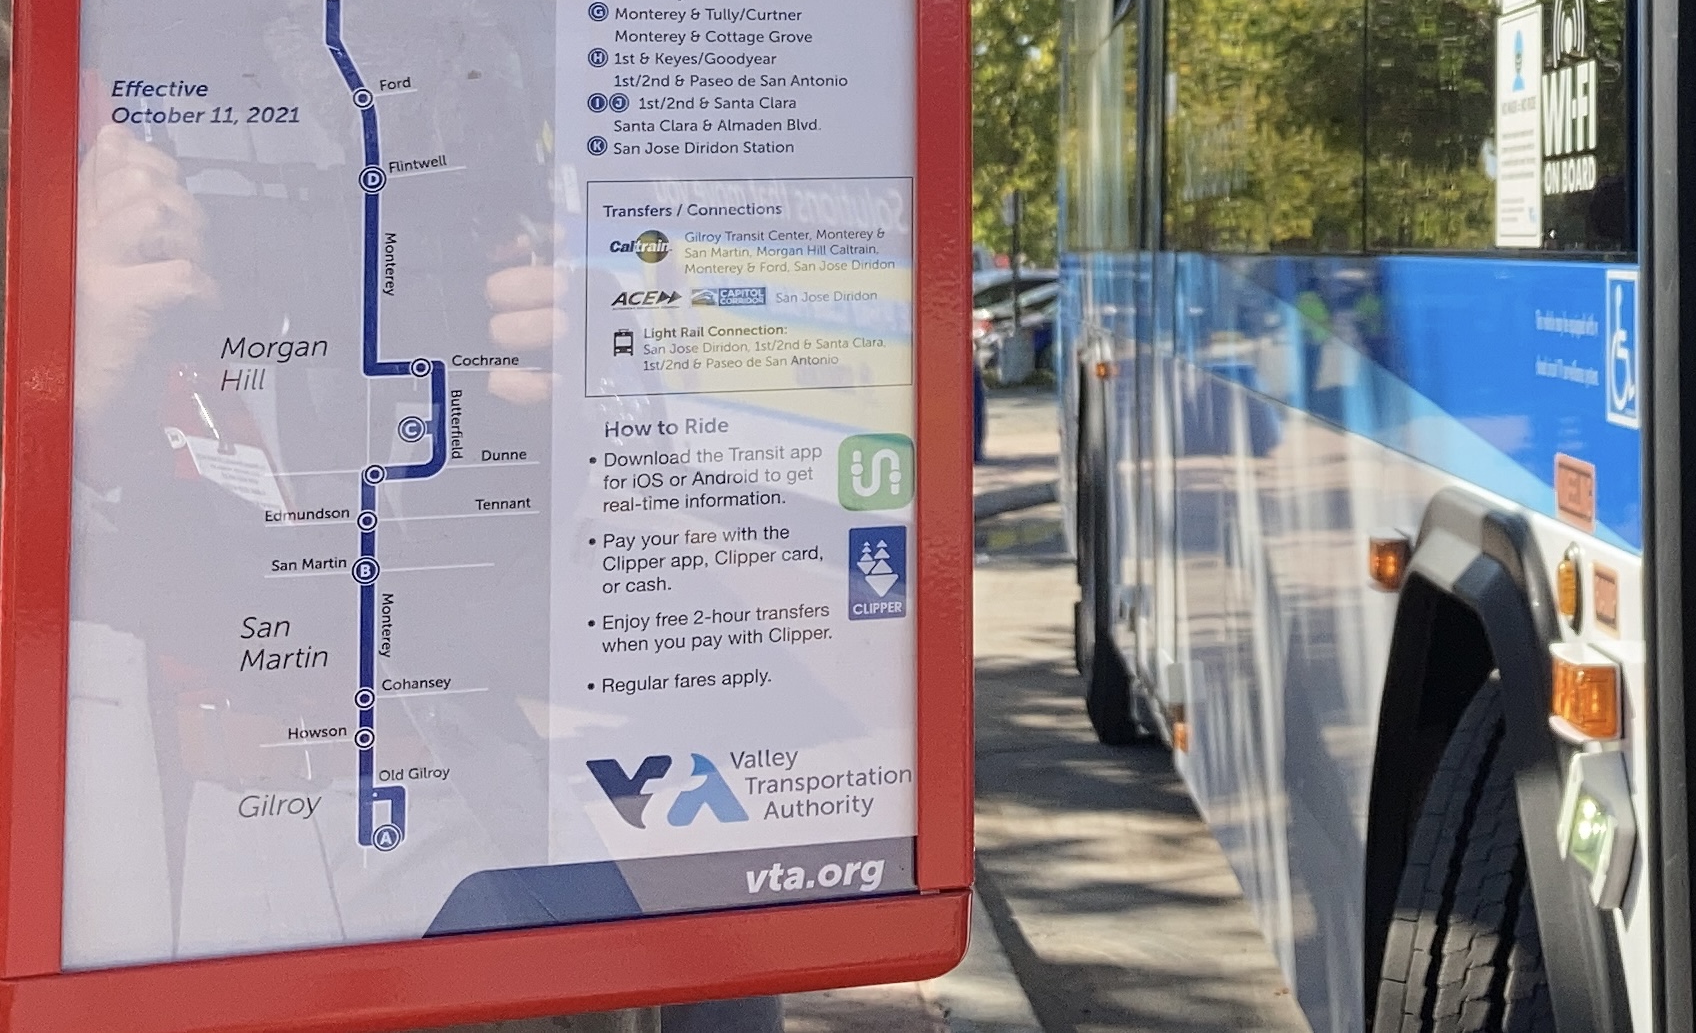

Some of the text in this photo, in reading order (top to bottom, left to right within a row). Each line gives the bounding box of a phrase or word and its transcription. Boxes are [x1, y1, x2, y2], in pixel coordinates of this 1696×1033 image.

[615, 7, 802, 23] Monterey & Tully/Curtner
[614, 52, 777, 68] 1st & Keyes/Goodyear
[379, 76, 412, 92] Ford
[614, 74, 848, 88] 1st/2nd & Paseo de San Antonio
[111, 80, 209, 99] Effective
[111, 106, 300, 125] October 11, 2021
[614, 119, 822, 132] Santa Clara & Almaden Blvd.
[614, 141, 795, 155] San Jose Diridon Station
[388, 155, 448, 174] Flintwell
[367, 173, 380, 186] D
[1544, 155, 1596, 196] ON BOARD
[603, 204, 672, 218] Transfers
[687, 202, 783, 217] Connections
[610, 239, 669, 253] Caltrain
[383, 232, 397, 297] Monterey
[610, 291, 655, 307] ACE
[720, 288, 764, 298] CAPITOL
[720, 297, 764, 305] CORRIDOR
[644, 325, 788, 340] Light Rail Connection:
[220, 336, 329, 364] Morgan
[451, 353, 520, 368] Cochrane
[220, 369, 265, 392] Hill
[450, 390, 464, 459] Butterfield
[605, 418, 729, 438] How to Ride
[481, 450, 527, 462] Dunne
[475, 497, 531, 511] Tennant
[264, 508, 350, 522] Edmundson
[271, 557, 347, 572] San Martin
[360, 565, 371, 578] B
[852, 600, 903, 616] CLIPPER
[240, 616, 290, 640] San
[378, 593, 394, 658] Monterey
[603, 604, 830, 636] Enjoy free 2-hour transfers
[240, 647, 328, 672] Martin
[381, 677, 452, 692] Cohansey
[602, 668, 772, 696] Regular fares apply.
[288, 726, 347, 740] Howson
[730, 748, 799, 770] Valley
[378, 767, 451, 782] Old Gilroy
[744, 766, 912, 797] Transportation
[238, 794, 322, 819] Gilroy
[763, 793, 875, 822] Authority
[745, 858, 885, 894] vta.org
